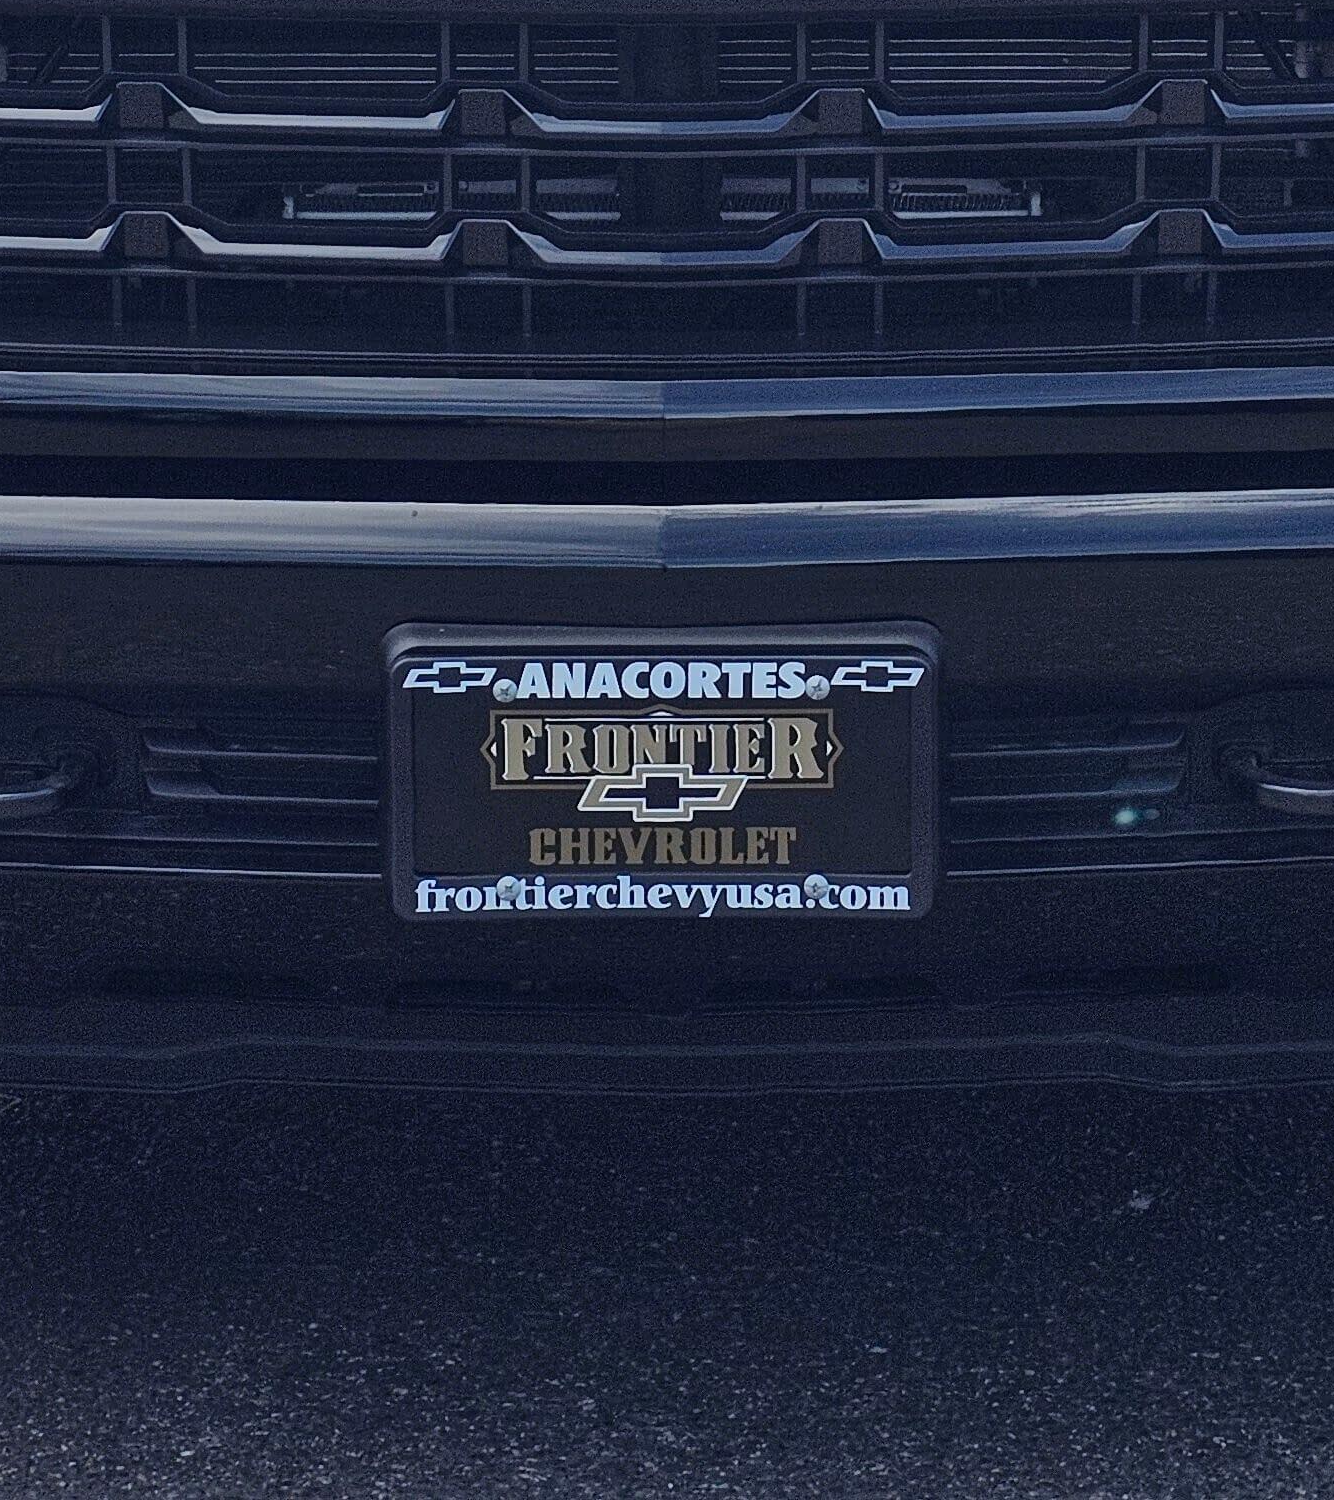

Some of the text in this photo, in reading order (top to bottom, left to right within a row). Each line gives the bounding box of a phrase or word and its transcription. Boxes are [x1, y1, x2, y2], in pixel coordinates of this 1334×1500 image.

[516, 662, 806, 699] ANACORTES
[501, 717, 823, 781] FRONTIER
[528, 827, 797, 866] CHEVROLET
[414, 876, 911, 918] frontierchevyusa.com
